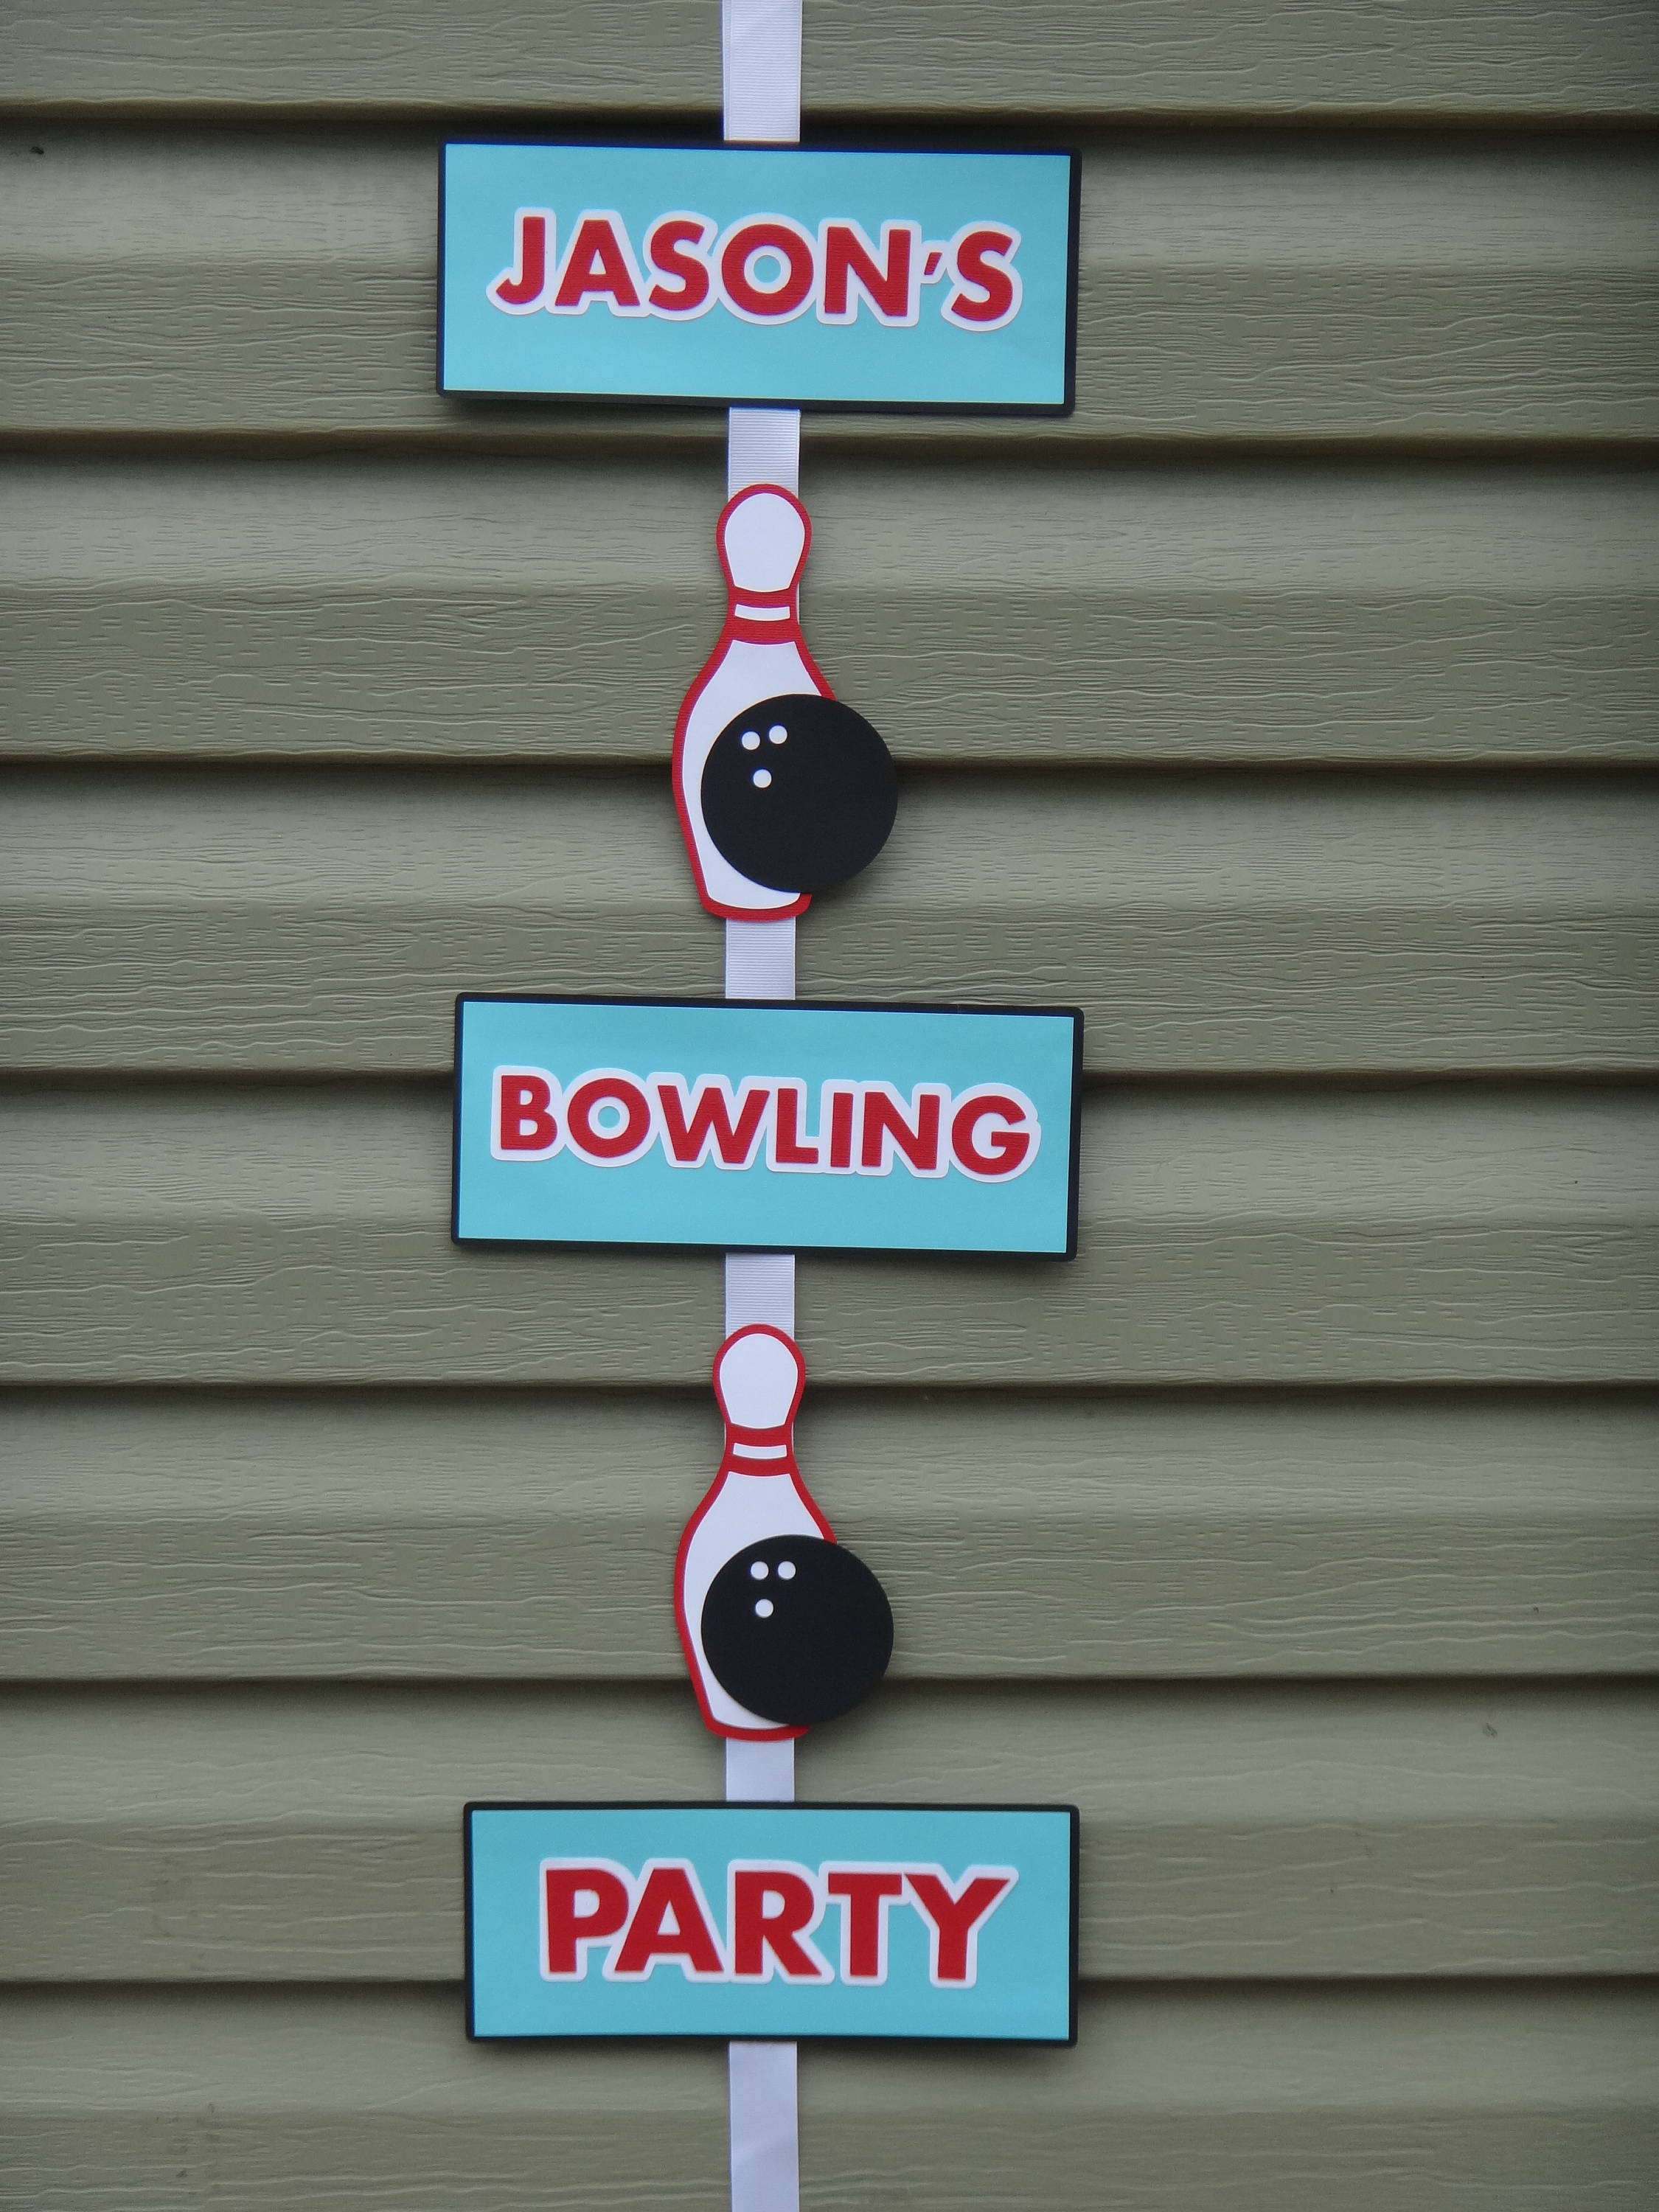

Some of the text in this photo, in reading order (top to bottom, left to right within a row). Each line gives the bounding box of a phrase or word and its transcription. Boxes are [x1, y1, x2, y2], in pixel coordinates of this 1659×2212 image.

[494, 215, 1015, 323] JASON'S
[499, 1074, 1032, 1175] BOWLING
[545, 1866, 1010, 1981] PARTY
